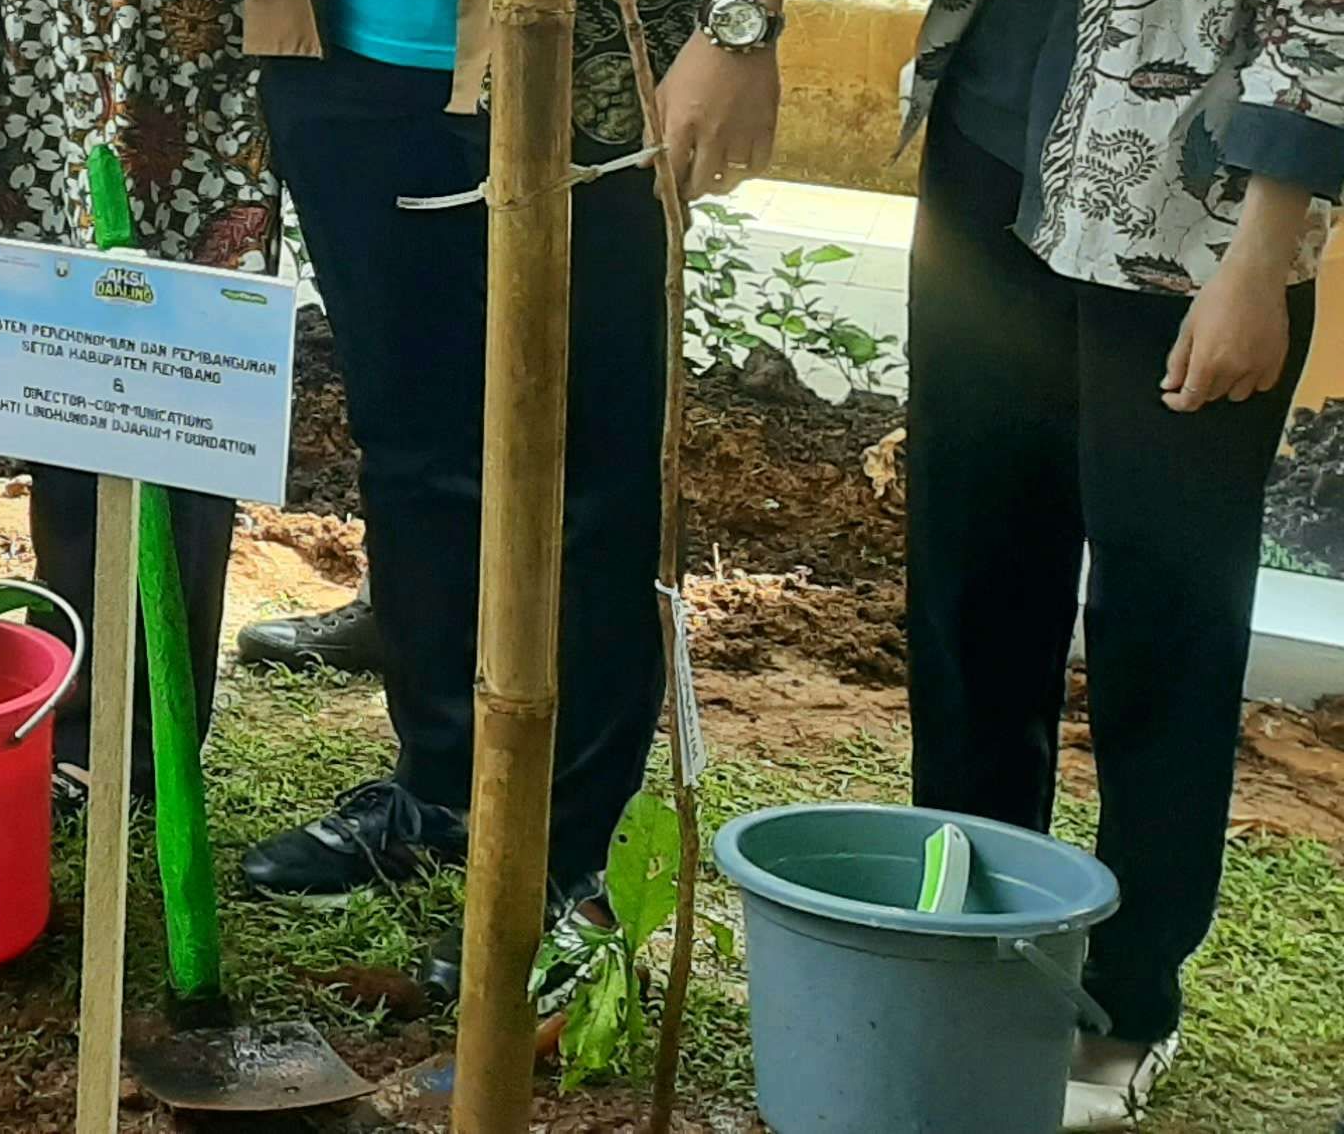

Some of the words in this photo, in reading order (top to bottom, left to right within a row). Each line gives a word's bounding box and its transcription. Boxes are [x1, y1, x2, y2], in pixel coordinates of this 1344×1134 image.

[21, 340, 64, 357] SETDA
[69, 347, 147, 372] KABUPATEN
[152, 361, 221, 384] REMBANG
[140, 341, 167, 356] DAN
[172, 346, 277, 375] PEMBANGUNAN
[113, 377, 124, 393] &
[112, 417, 170, 441] DJARUM
[175, 430, 256, 456] FOUNDATION
